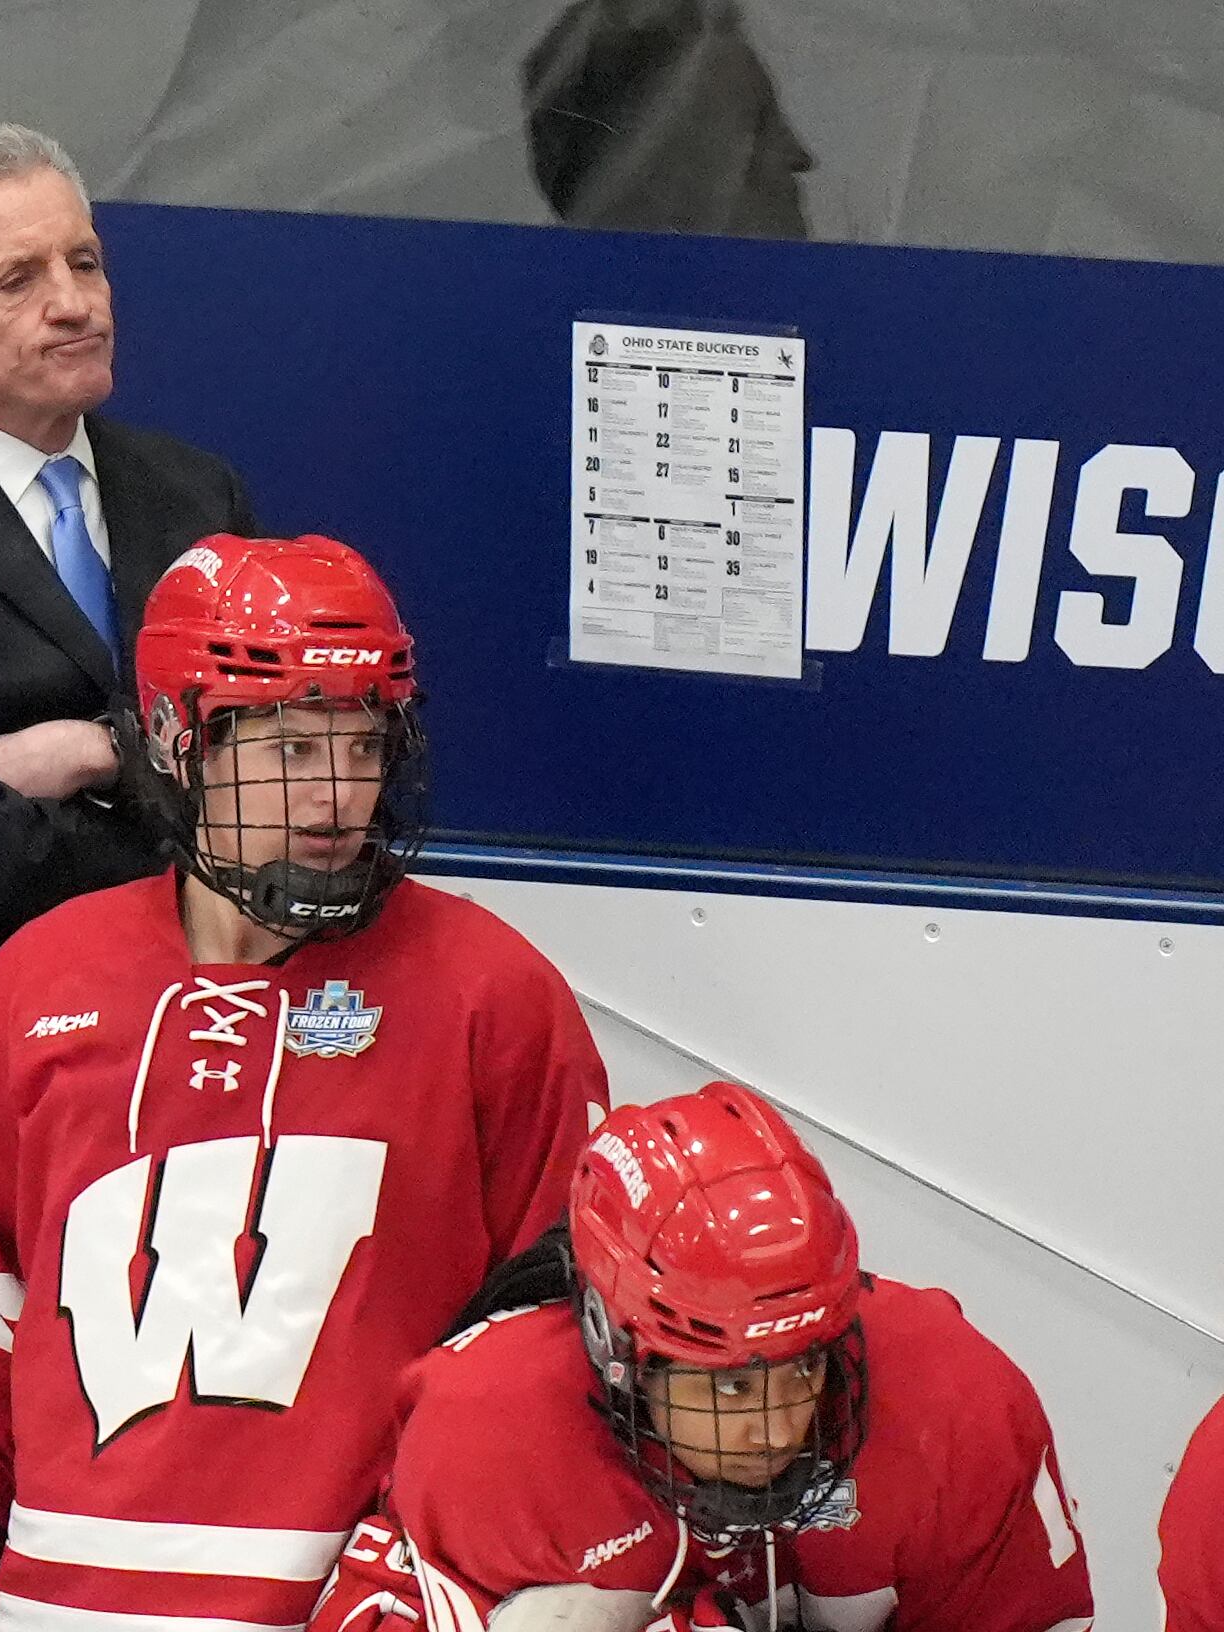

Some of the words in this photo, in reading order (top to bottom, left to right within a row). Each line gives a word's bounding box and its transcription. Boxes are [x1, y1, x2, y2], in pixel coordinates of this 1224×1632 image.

[622, 336, 654, 349] OHIO
[657, 339, 693, 352] STATE
[696, 341, 760, 357] BUCKEYES
[587, 368, 599, 383] 12
[658, 373, 670, 389] 10
[732, 379, 739, 393] 8
[587, 398, 599, 412] 16
[658, 403, 669, 418] 17
[730, 408, 739, 423] 9
[588, 428, 598, 442] 11
[656, 433, 670, 448] 22
[728, 438, 740, 453] 21
[586, 457, 600, 472] 20
[656, 462, 670, 478] 27
[728, 468, 740, 483] 15
[589, 486, 596, 501] 5
[731, 502, 736, 516] 1
[589, 520, 595, 535] 7
[726, 530, 740, 546] 30
[805, 427, 1224, 675] WIS
[657, 555, 669, 571] 13
[588, 580, 595, 594] 4
[655, 585, 669, 600] 23
[302, 648, 382, 666] CCM
[289, 901, 361, 919] CCM
[291, 1014, 341, 1029] FROZEN
[341, 1014, 373, 1028] FOUR
[56, 1134, 389, 1459] W
[743, 1305, 827, 1338] CCM
